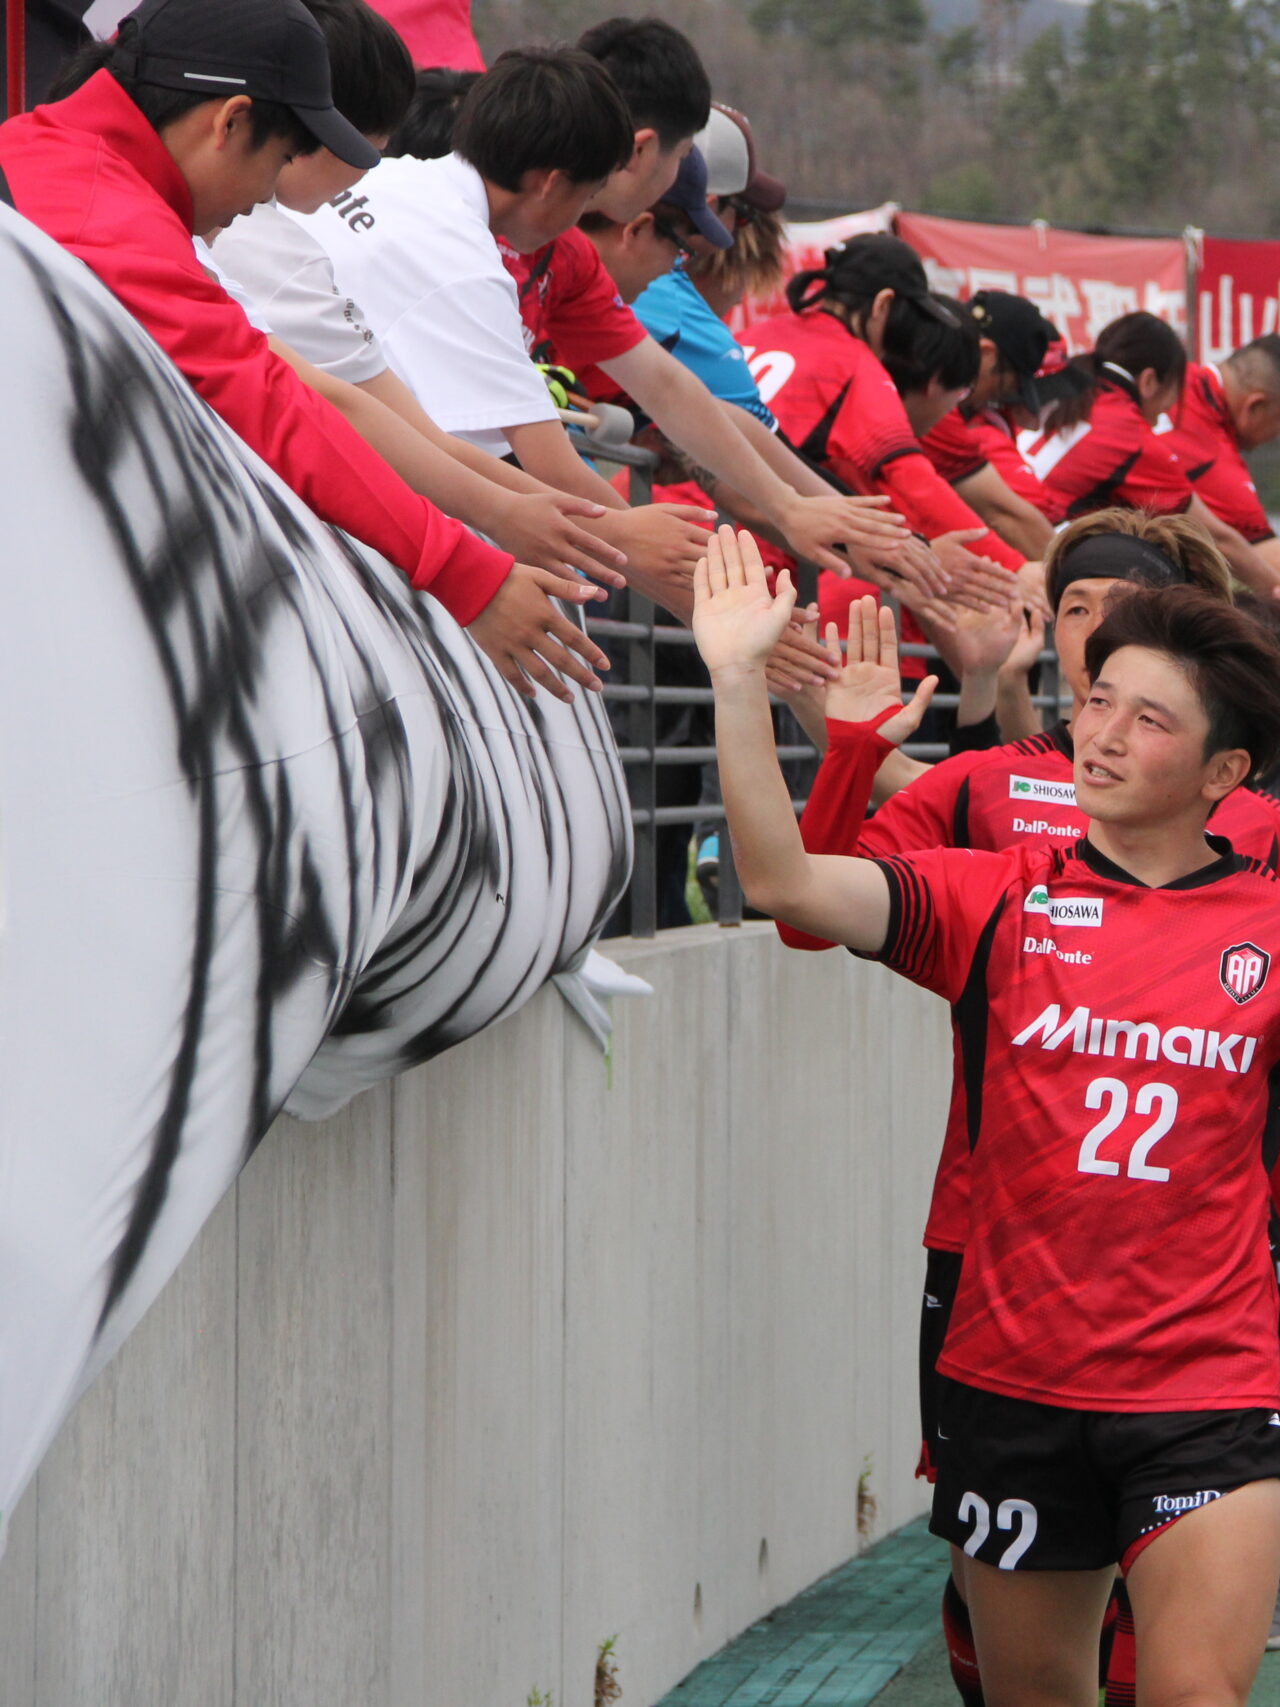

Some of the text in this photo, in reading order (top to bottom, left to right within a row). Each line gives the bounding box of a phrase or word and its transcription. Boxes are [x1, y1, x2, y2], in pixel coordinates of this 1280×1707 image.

[1033, 783, 1077, 799] SHIOSAW
[1013, 818, 1081, 837] DalPonte
[1049, 905, 1100, 920] HIOSAWA
[1023, 937, 1093, 965] DalPonte
[1077, 1077, 1178, 1182] 22
[1152, 1489, 1228, 1513] TomiD
[958, 1491, 1038, 1571] 22
